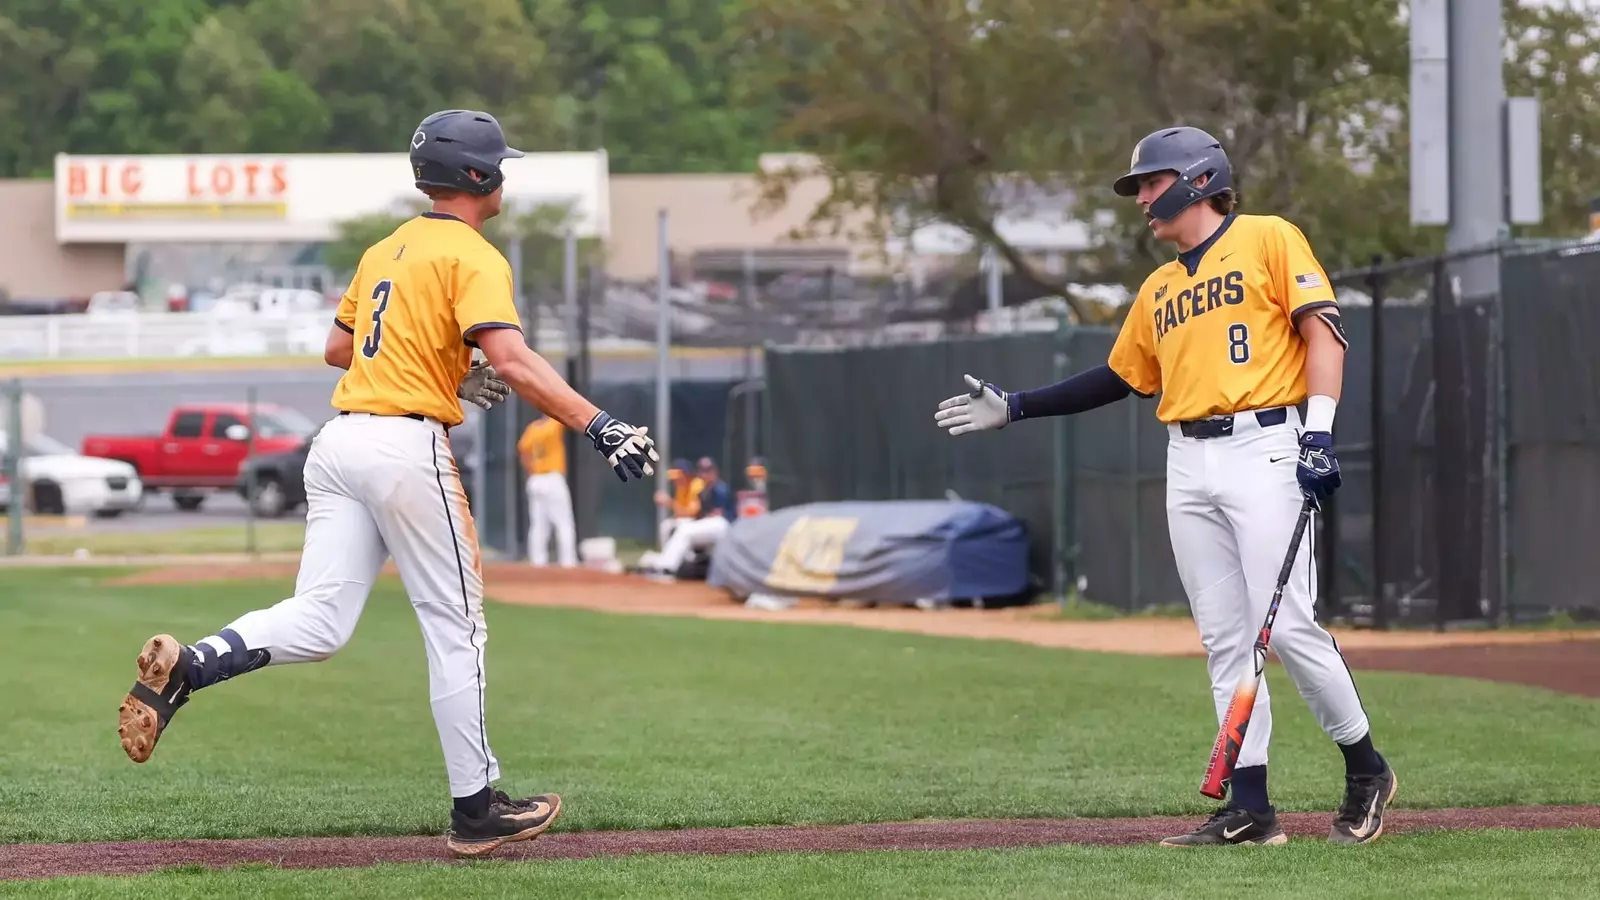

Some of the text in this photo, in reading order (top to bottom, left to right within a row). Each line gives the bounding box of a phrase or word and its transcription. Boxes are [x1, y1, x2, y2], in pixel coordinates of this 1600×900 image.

[67, 162, 287, 196] BIG LOTS
[361, 279, 392, 359] 3
[1154, 271, 1244, 344] RACERS
[1228, 322, 1251, 365] 8
